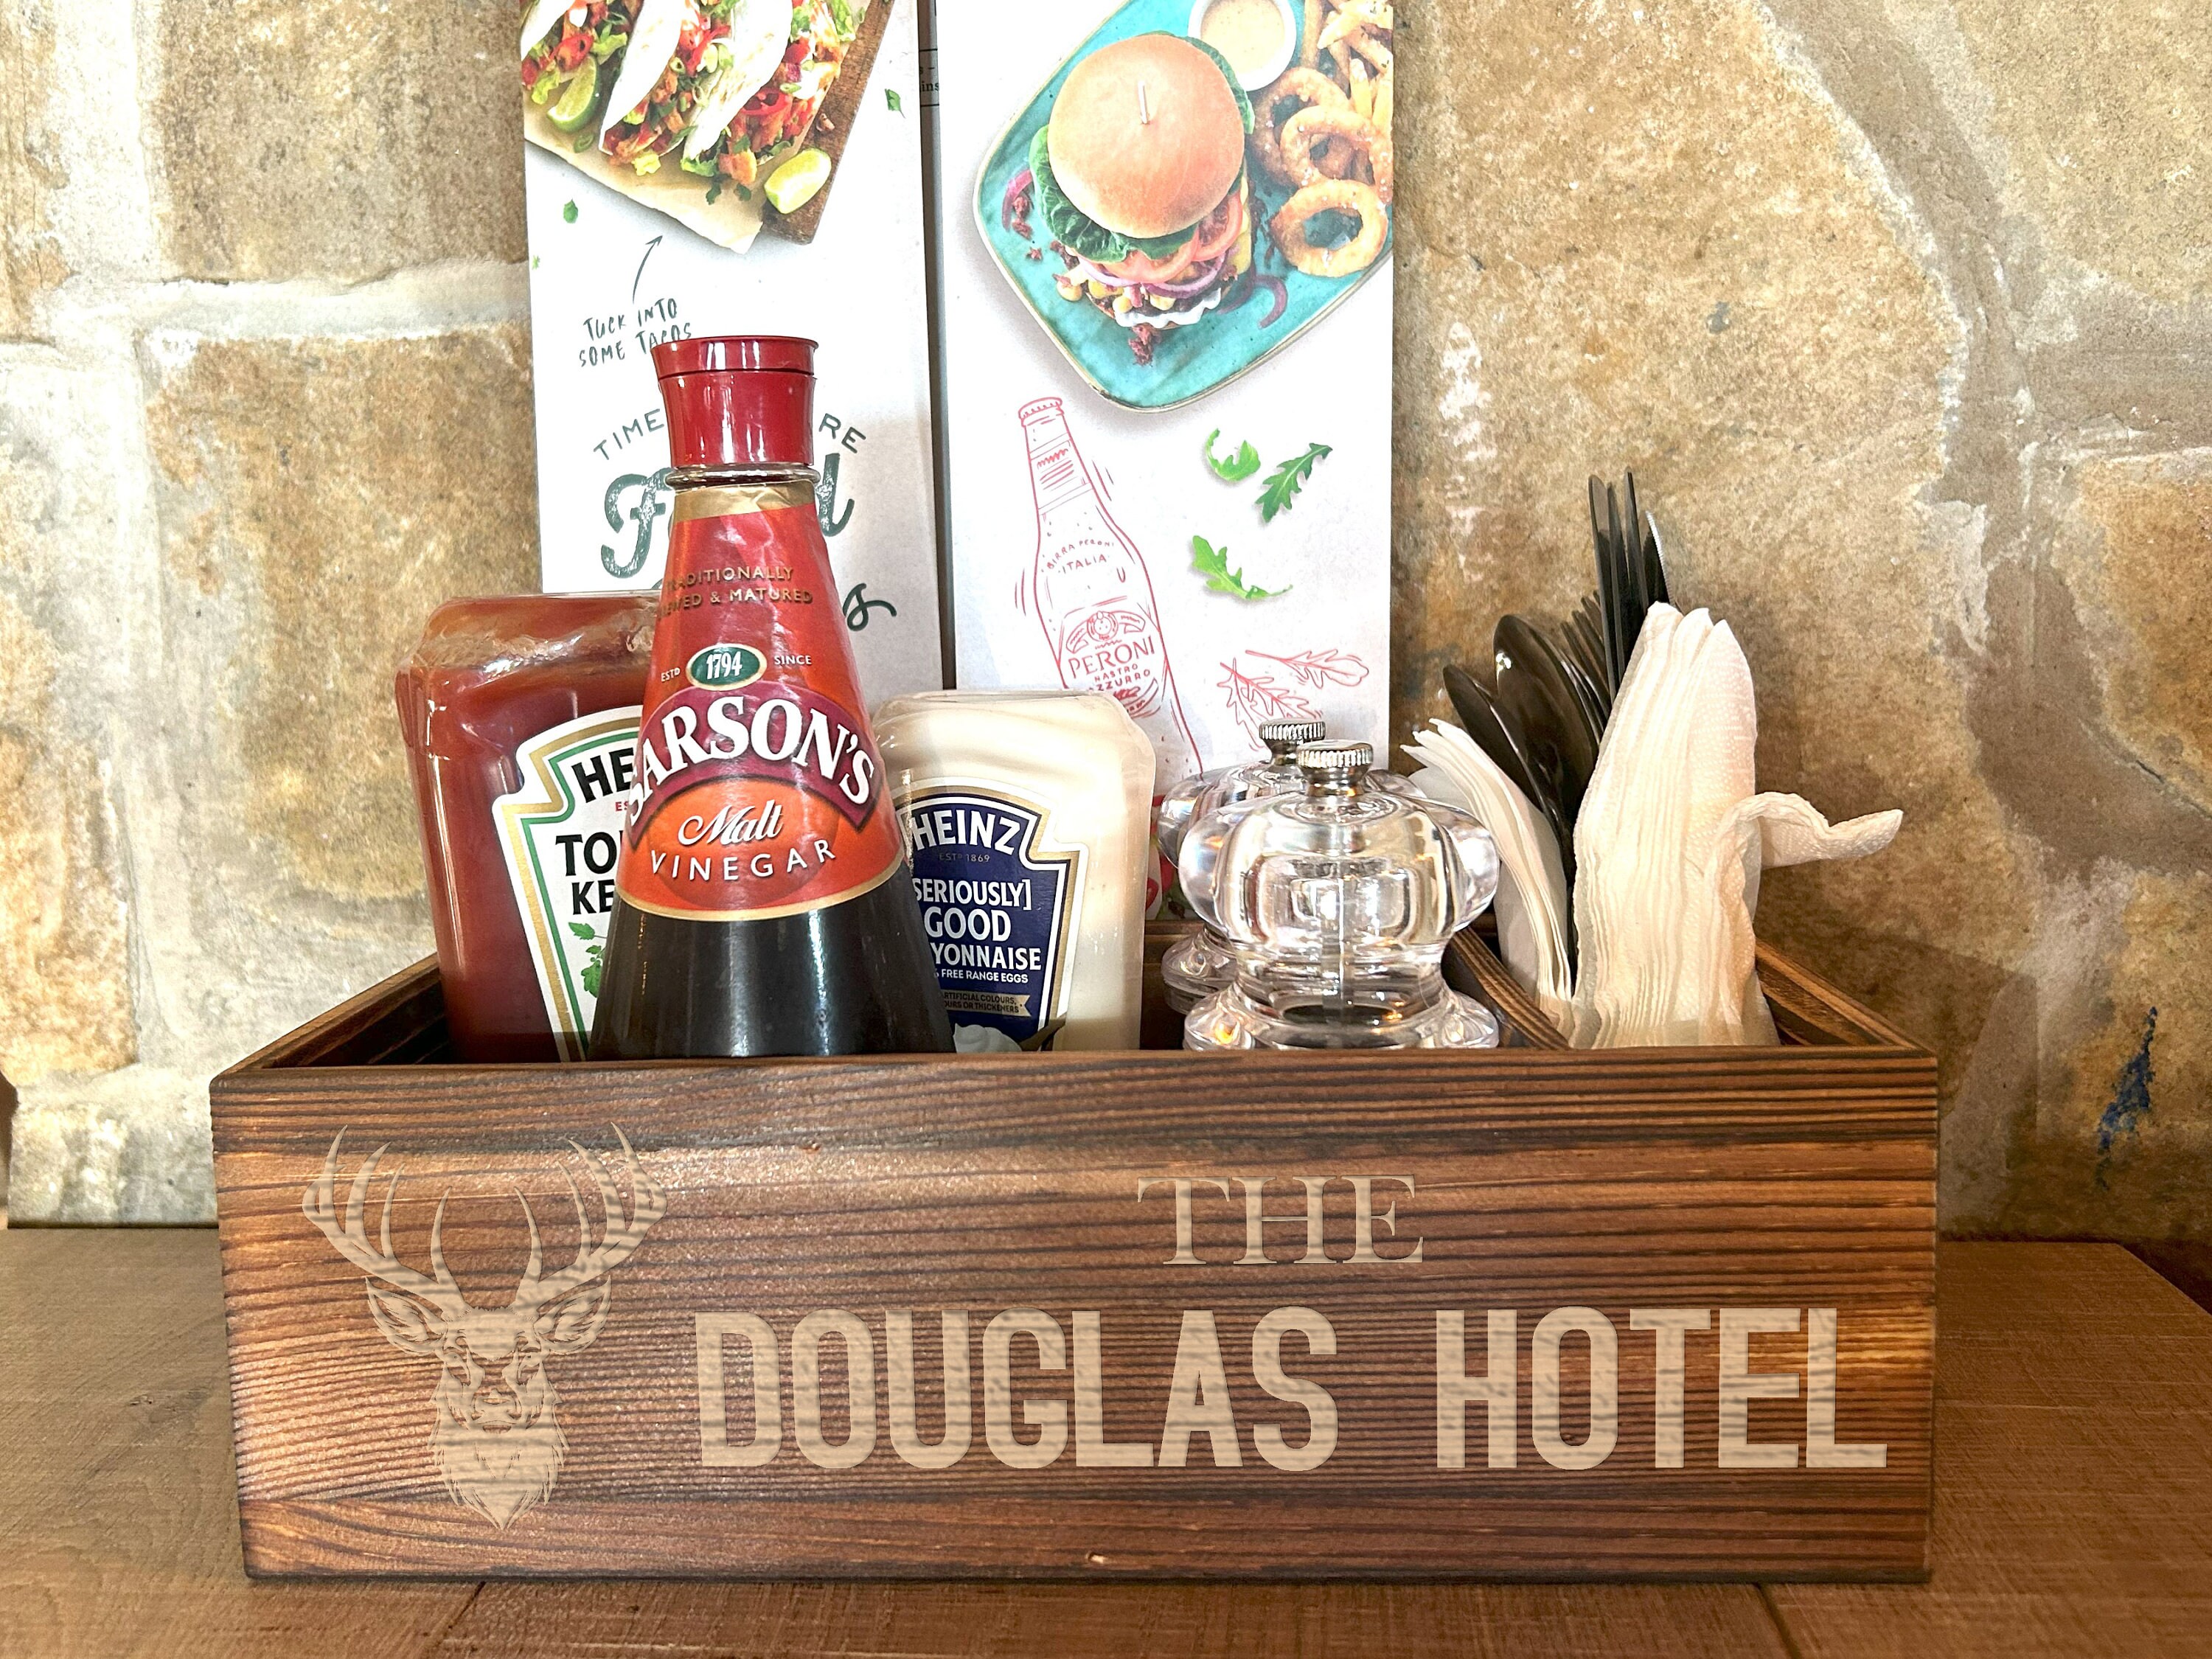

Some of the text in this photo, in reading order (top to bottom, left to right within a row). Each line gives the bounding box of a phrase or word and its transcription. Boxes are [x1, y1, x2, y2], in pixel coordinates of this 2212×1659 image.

[583, 298, 677, 341] TUCK INTO
[579, 341, 625, 367] SOME
[594, 408, 866, 461] TIME RE
[1046, 543, 1075, 569] BIRRA
[1062, 554, 1107, 574] ITALIA
[666, 566, 794, 591] RADITIONALLY
[710, 591, 721, 604] &
[729, 588, 813, 604] MATURED
[661, 651, 813, 683] ESTD 1794 SINCE
[1068, 635, 1155, 679] PERONI
[1088, 669, 1151, 692] ZZURRO
[1094, 663, 1138, 683] NASTRO
[677, 799, 785, 846] Malt
[911, 809, 1020, 855] HEINZ
[650, 838, 836, 882] VINEGAR
[966, 853, 990, 863] 1869
[912, 877, 1032, 911] SERIOUSLY]
[923, 905, 1012, 942] GOOD
[930, 942, 1042, 971] YONNAISE
[941, 968, 964, 979] FREE
[966, 970, 999, 982] RANGE
[1001, 973, 1029, 984] EGGS
[944, 992, 979, 1002] RTIFICIAL
[963, 1001, 972, 1009] OR
[1137, 1174, 1424, 1265] THE
[695, 1306, 1888, 1472] DOUGLAS HOTEL
